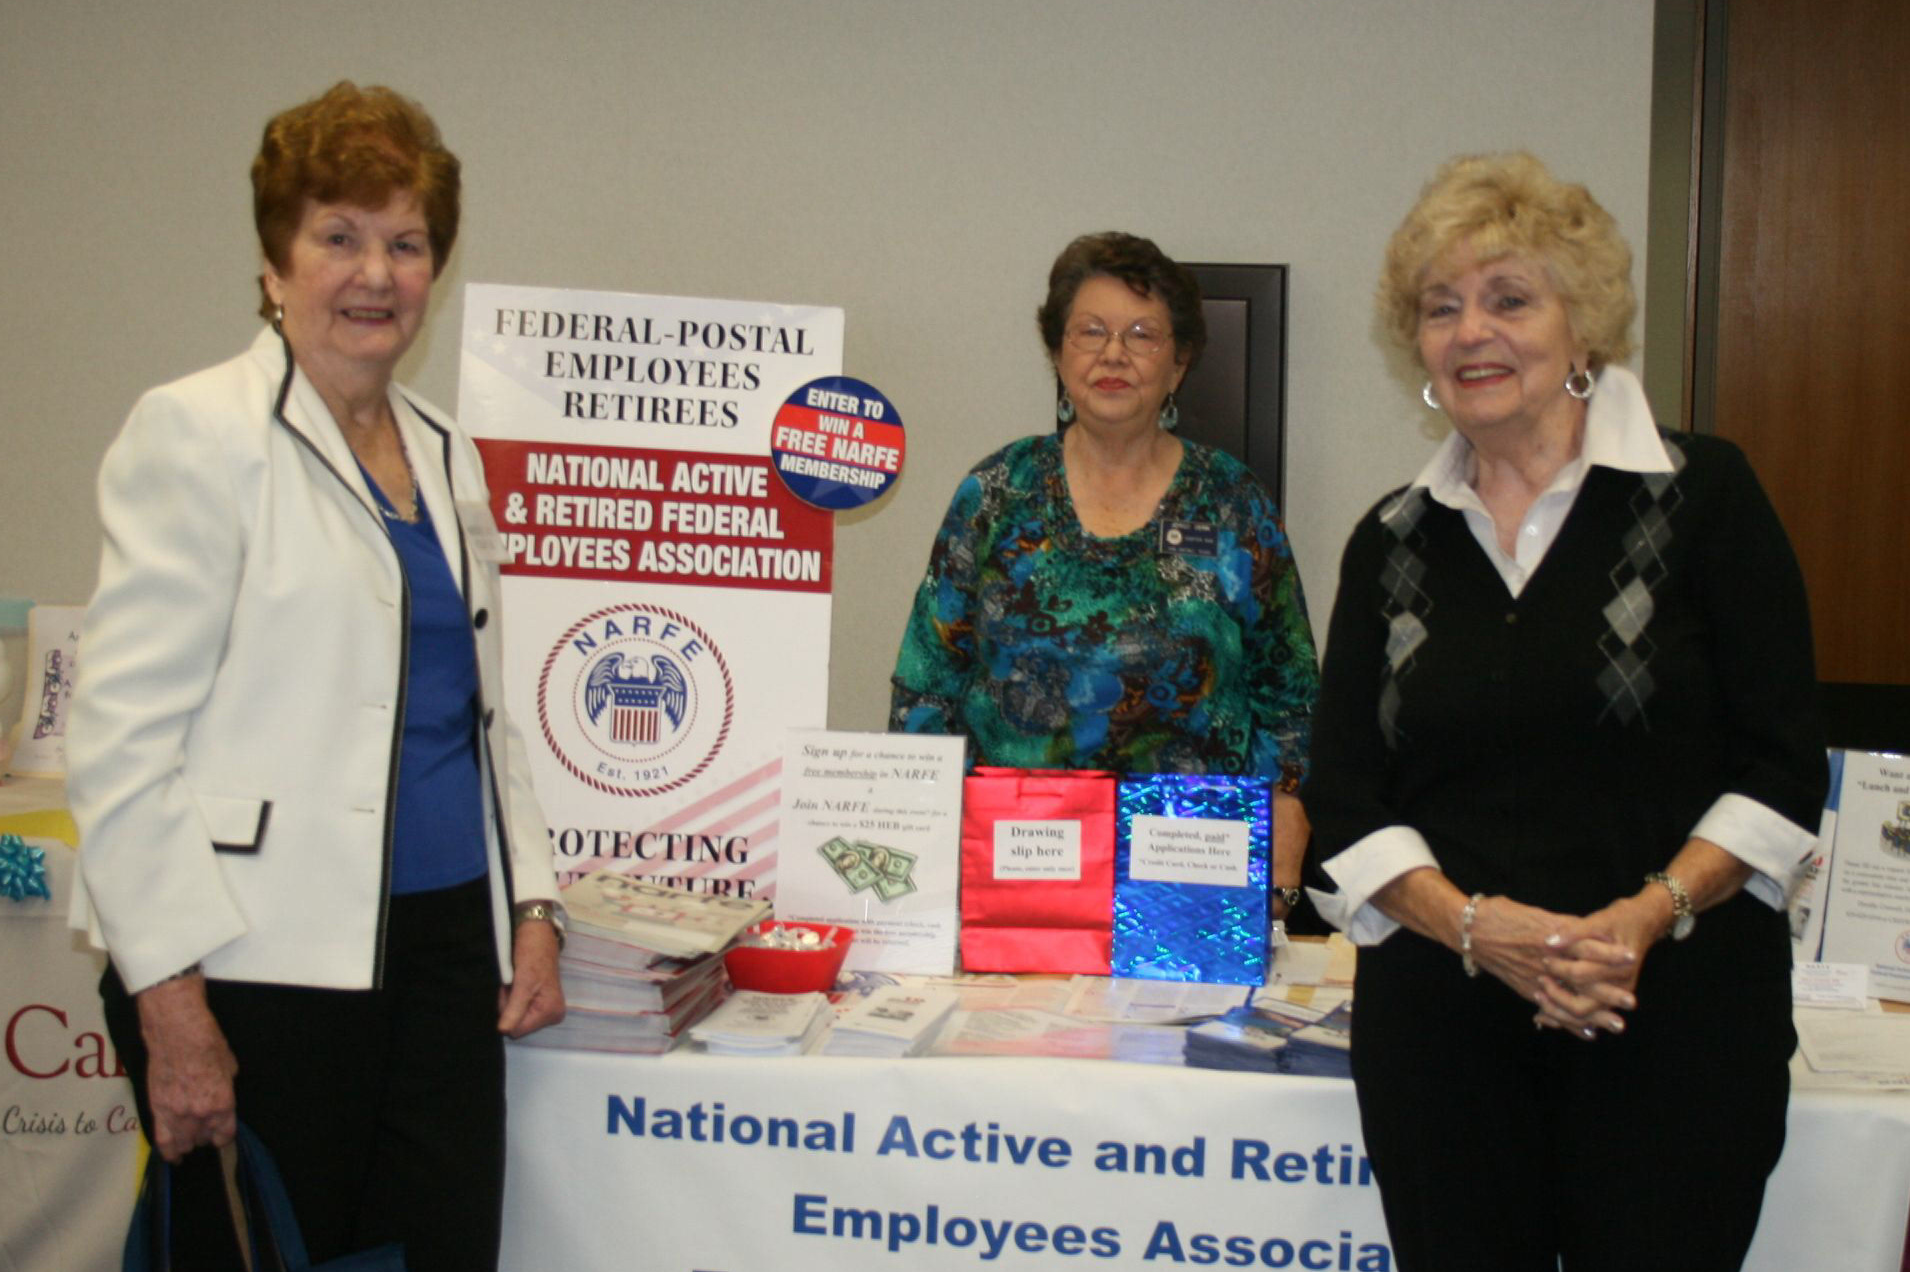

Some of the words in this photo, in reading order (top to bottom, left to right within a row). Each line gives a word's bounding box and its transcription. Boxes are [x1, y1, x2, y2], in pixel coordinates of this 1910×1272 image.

[495, 308, 814, 356] FEDERAL-POSTAL
[543, 351, 761, 391] EMPLOYEES
[563, 390, 739, 428] RETIREES
[806, 387, 860, 414] ENTER
[863, 398, 884, 420] TO
[818, 414, 850, 437] WIN
[852, 421, 864, 440] A
[775, 426, 828, 457] FREE
[831, 437, 900, 471] NARFE
[527, 453, 664, 491] NATIONAL
[671, 462, 768, 498] ACTIVE
[780, 453, 886, 490] MEMBERSHIP
[505, 492, 528, 524] &
[536, 494, 653, 531] RETIRED
[661, 503, 784, 540] FEDERAL
[500, 533, 630, 572] PLOYEES
[638, 541, 821, 582] ASSOCIATION
[573, 616, 704, 662] NARFE
[597, 761, 626, 781] Est.
[634, 766, 670, 781] 1921
[802, 745, 829, 758] Sign
[832, 749, 848, 760] up
[891, 768, 940, 780] NARFE
[792, 798, 818, 811] Join
[822, 799, 869, 812] NARFE
[1010, 826, 1065, 840] Drawing
[1010, 845, 1033, 858] slip
[1037, 845, 1064, 856] here
[1149, 843, 1206, 855] Applications
[1208, 847, 1231, 856] Here
[2, 1105, 66, 1135] Crisis
[75, 1111, 97, 1134] to
[606, 1094, 855, 1154] National
[876, 1115, 1073, 1168] Active
[1094, 1136, 1206, 1178] and
[792, 1193, 1121, 1261] Employees
[1142, 1220, 1391, 1272] Associa
